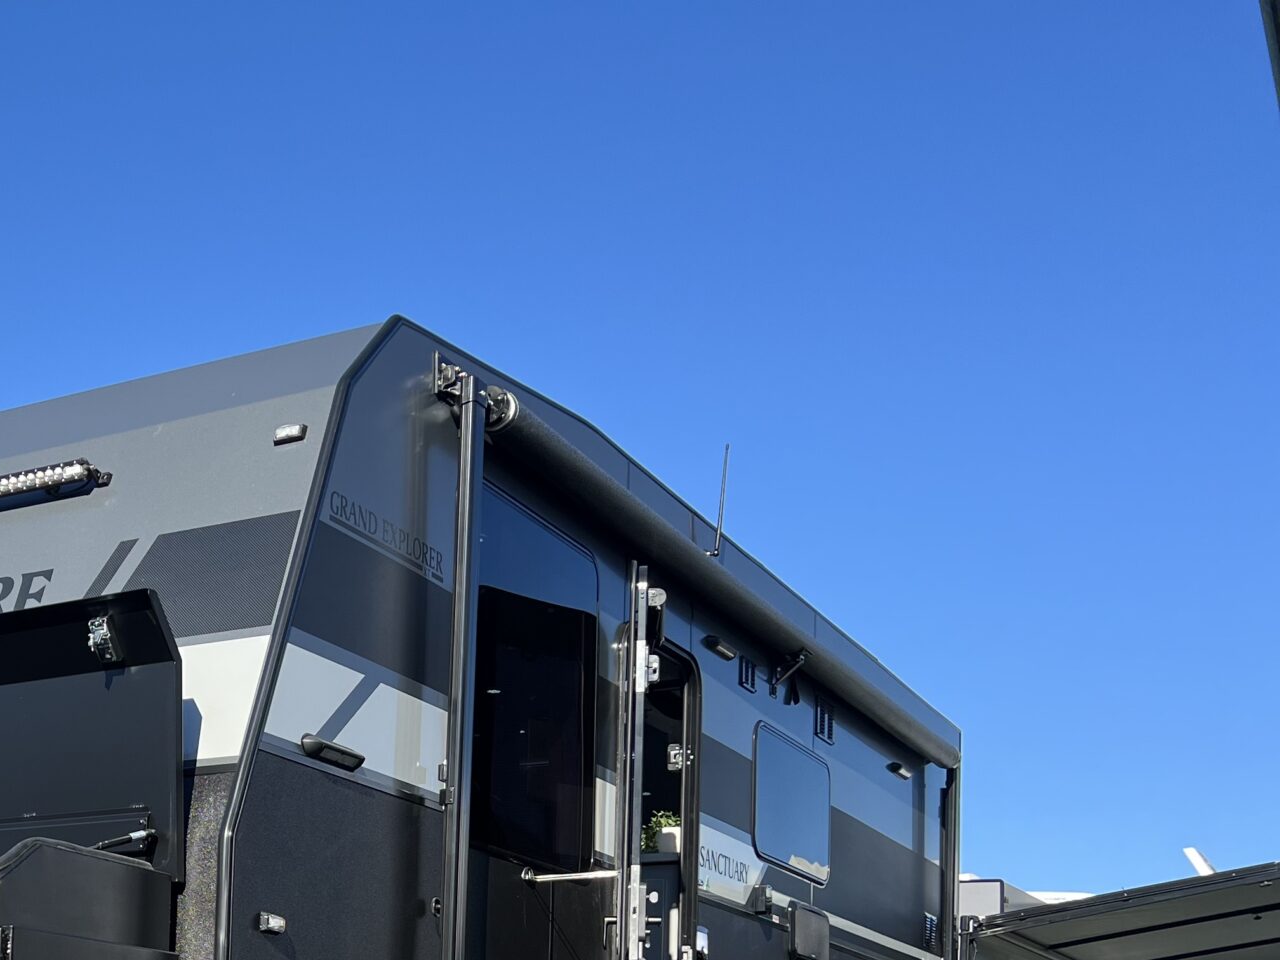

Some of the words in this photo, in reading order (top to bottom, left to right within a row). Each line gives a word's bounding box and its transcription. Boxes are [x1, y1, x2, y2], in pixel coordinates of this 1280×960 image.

[330, 491, 378, 535] GRAND
[382, 518, 443, 575] EXPLORER
[700, 846, 749, 884] SANCTUARY
